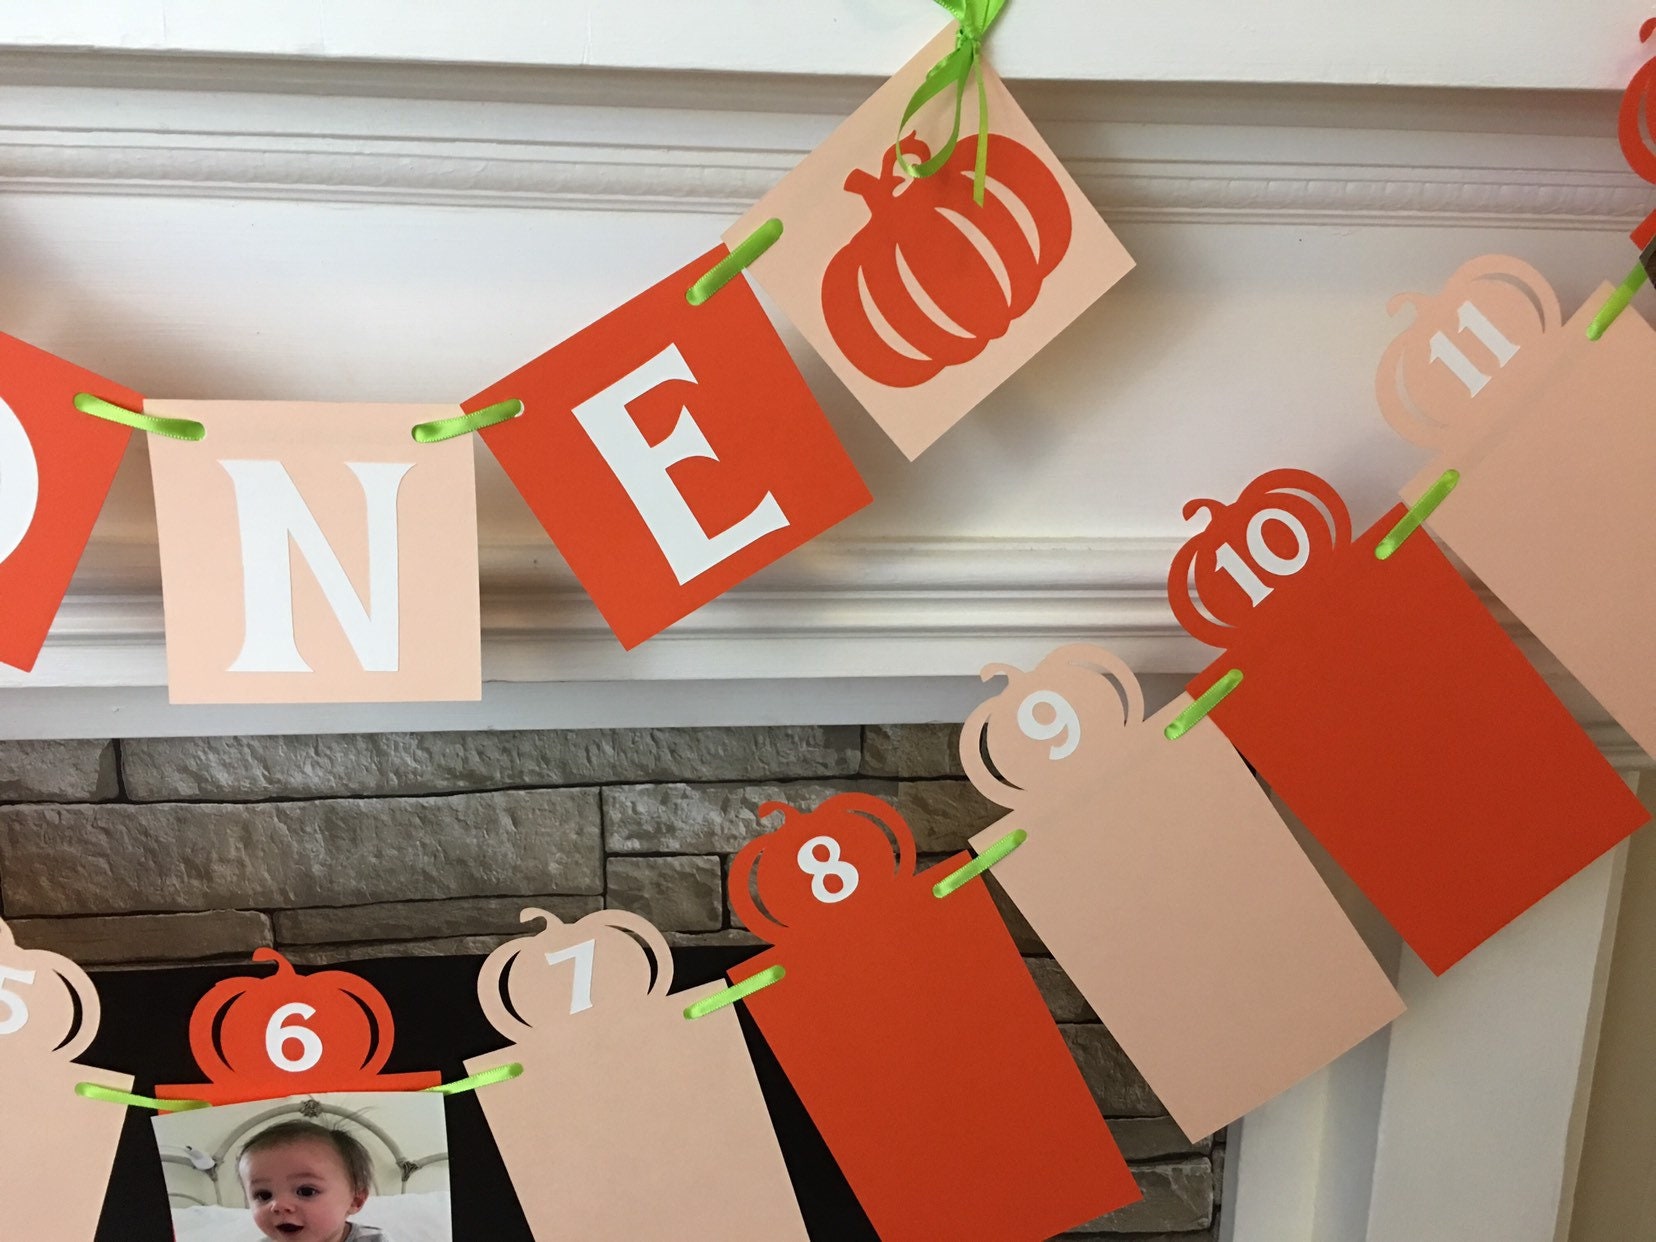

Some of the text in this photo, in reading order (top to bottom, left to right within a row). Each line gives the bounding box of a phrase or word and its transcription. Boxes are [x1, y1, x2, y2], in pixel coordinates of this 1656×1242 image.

[1428, 300, 1521, 399] 11
[0, 342, 791, 674] NE
[1213, 507, 1312, 608] 10
[1016, 689, 1083, 761] 9
[796, 835, 861, 905] 8
[544, 939, 598, 1015] 7
[264, 1002, 324, 1073] 6
